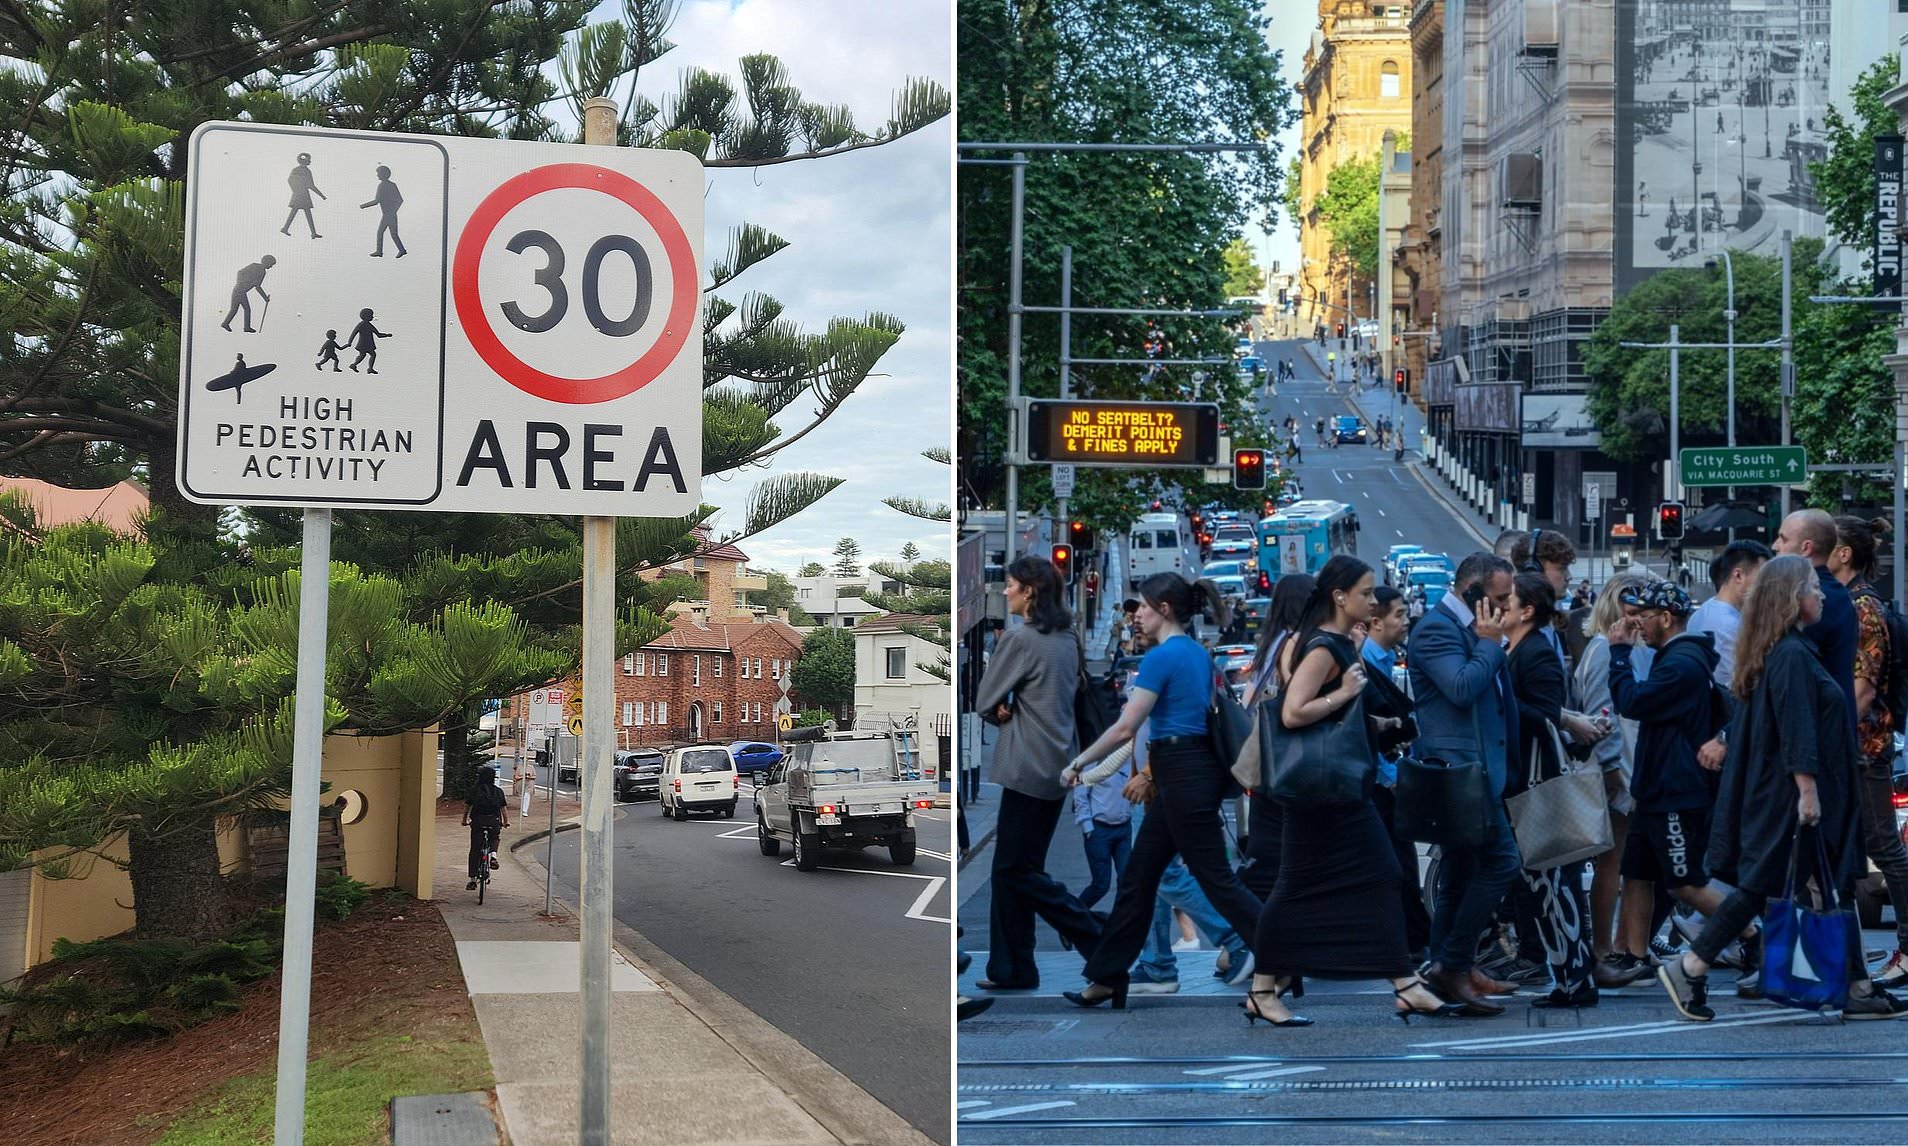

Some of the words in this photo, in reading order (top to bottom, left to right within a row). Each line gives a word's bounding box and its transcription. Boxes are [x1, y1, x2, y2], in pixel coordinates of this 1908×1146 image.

[1879, 171, 1900, 180] THE
[1877, 181, 1900, 277] REPUBLIC
[499, 229, 653, 338] 30
[279, 396, 353, 422] HIGH
[1071, 411, 1090, 425] NO
[1097, 411, 1174, 426] SEATBELT?
[216, 423, 413, 454] PEDESTRIAN
[1063, 424, 1123, 439] DEMERIT
[1130, 426, 1182, 440] POINTS
[455, 419, 688, 494] AREA
[1067, 438, 1077, 452] &
[1084, 439, 1127, 453] FINES
[1135, 440, 1178, 454] APPLY
[242, 454, 386, 482] ACTIVITY
[1057, 466, 1070, 474] NO
[1693, 455, 1724, 468] City
[1733, 454, 1775, 465] South
[1688, 471, 1704, 480] VIA
[1708, 470, 1765, 480] MACQUARIE
[1770, 468, 1781, 478] ST
[1666, 812, 1688, 878] adidas
